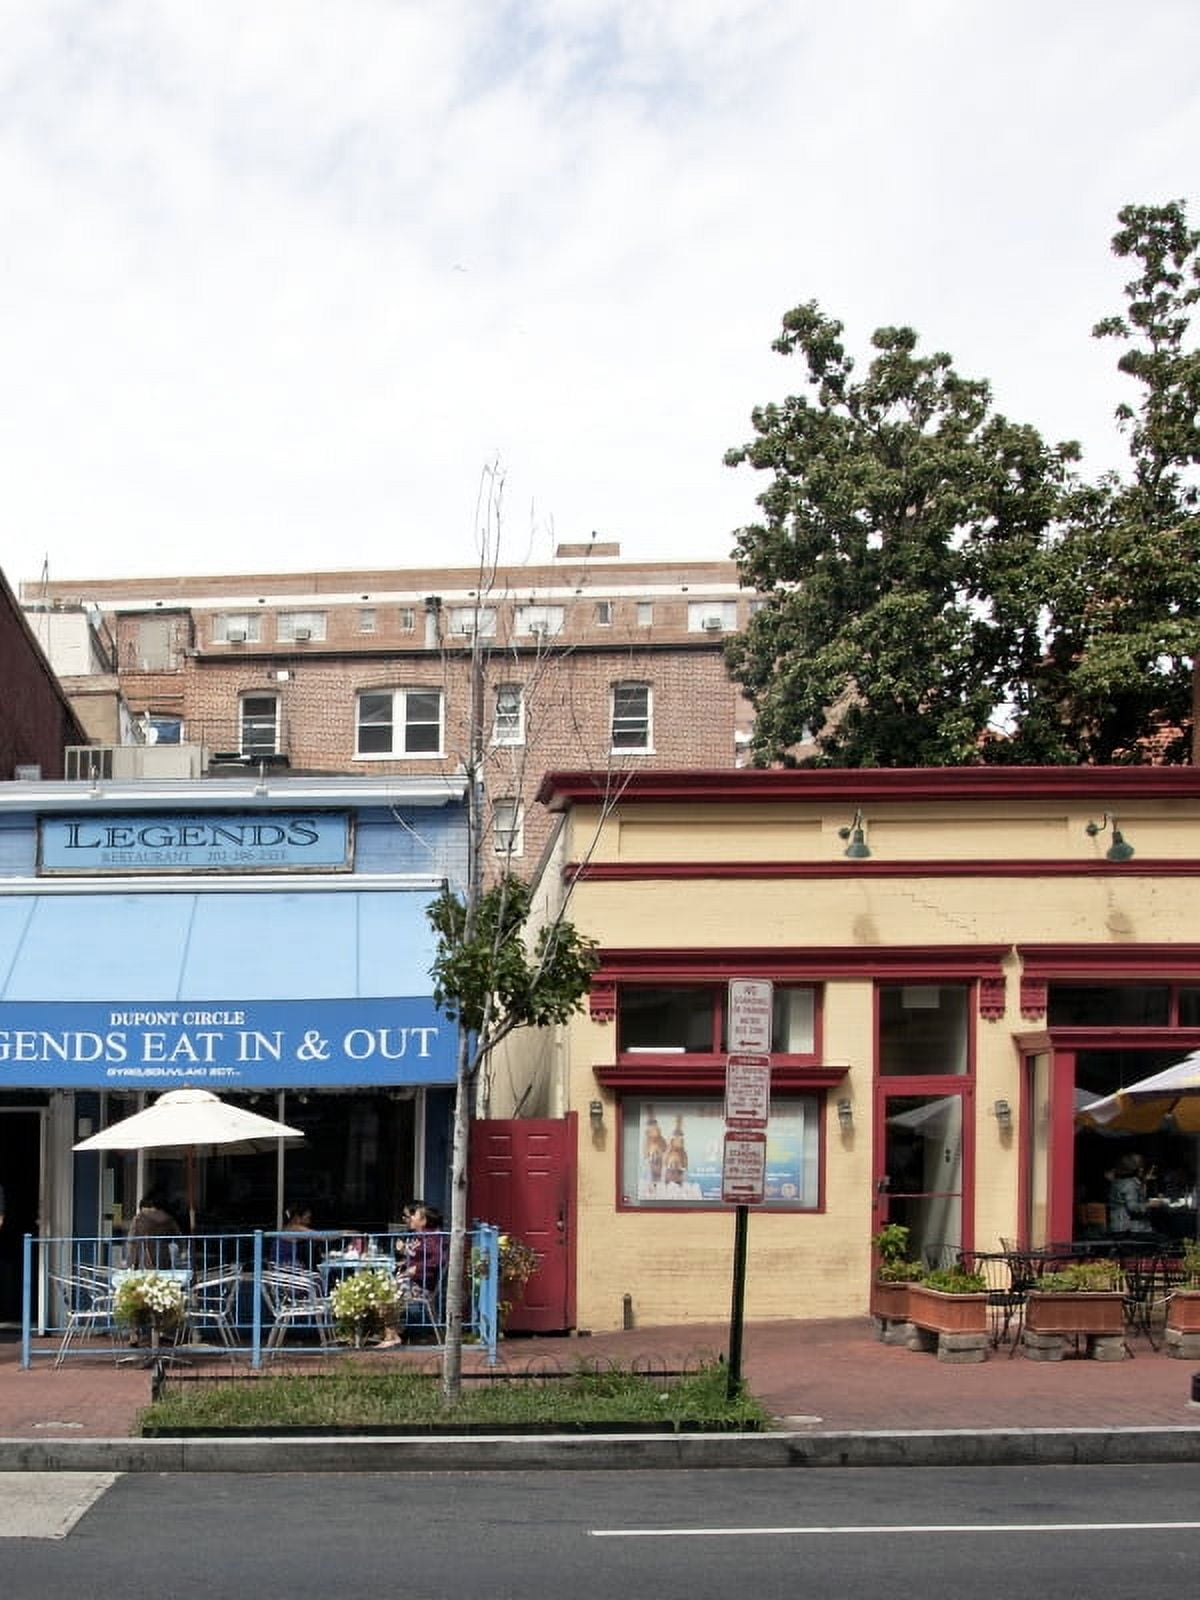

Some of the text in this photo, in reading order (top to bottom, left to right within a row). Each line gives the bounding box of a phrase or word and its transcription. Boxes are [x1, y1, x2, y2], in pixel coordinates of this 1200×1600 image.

[64, 819, 320, 849] LEGENDS
[110, 1011, 245, 1025] DUPONT CIRCLE
[140, 1031, 224, 1062] EAT
[237, 1030, 284, 1060] IN
[296, 1028, 330, 1060] &
[343, 1026, 439, 1060] OUT
